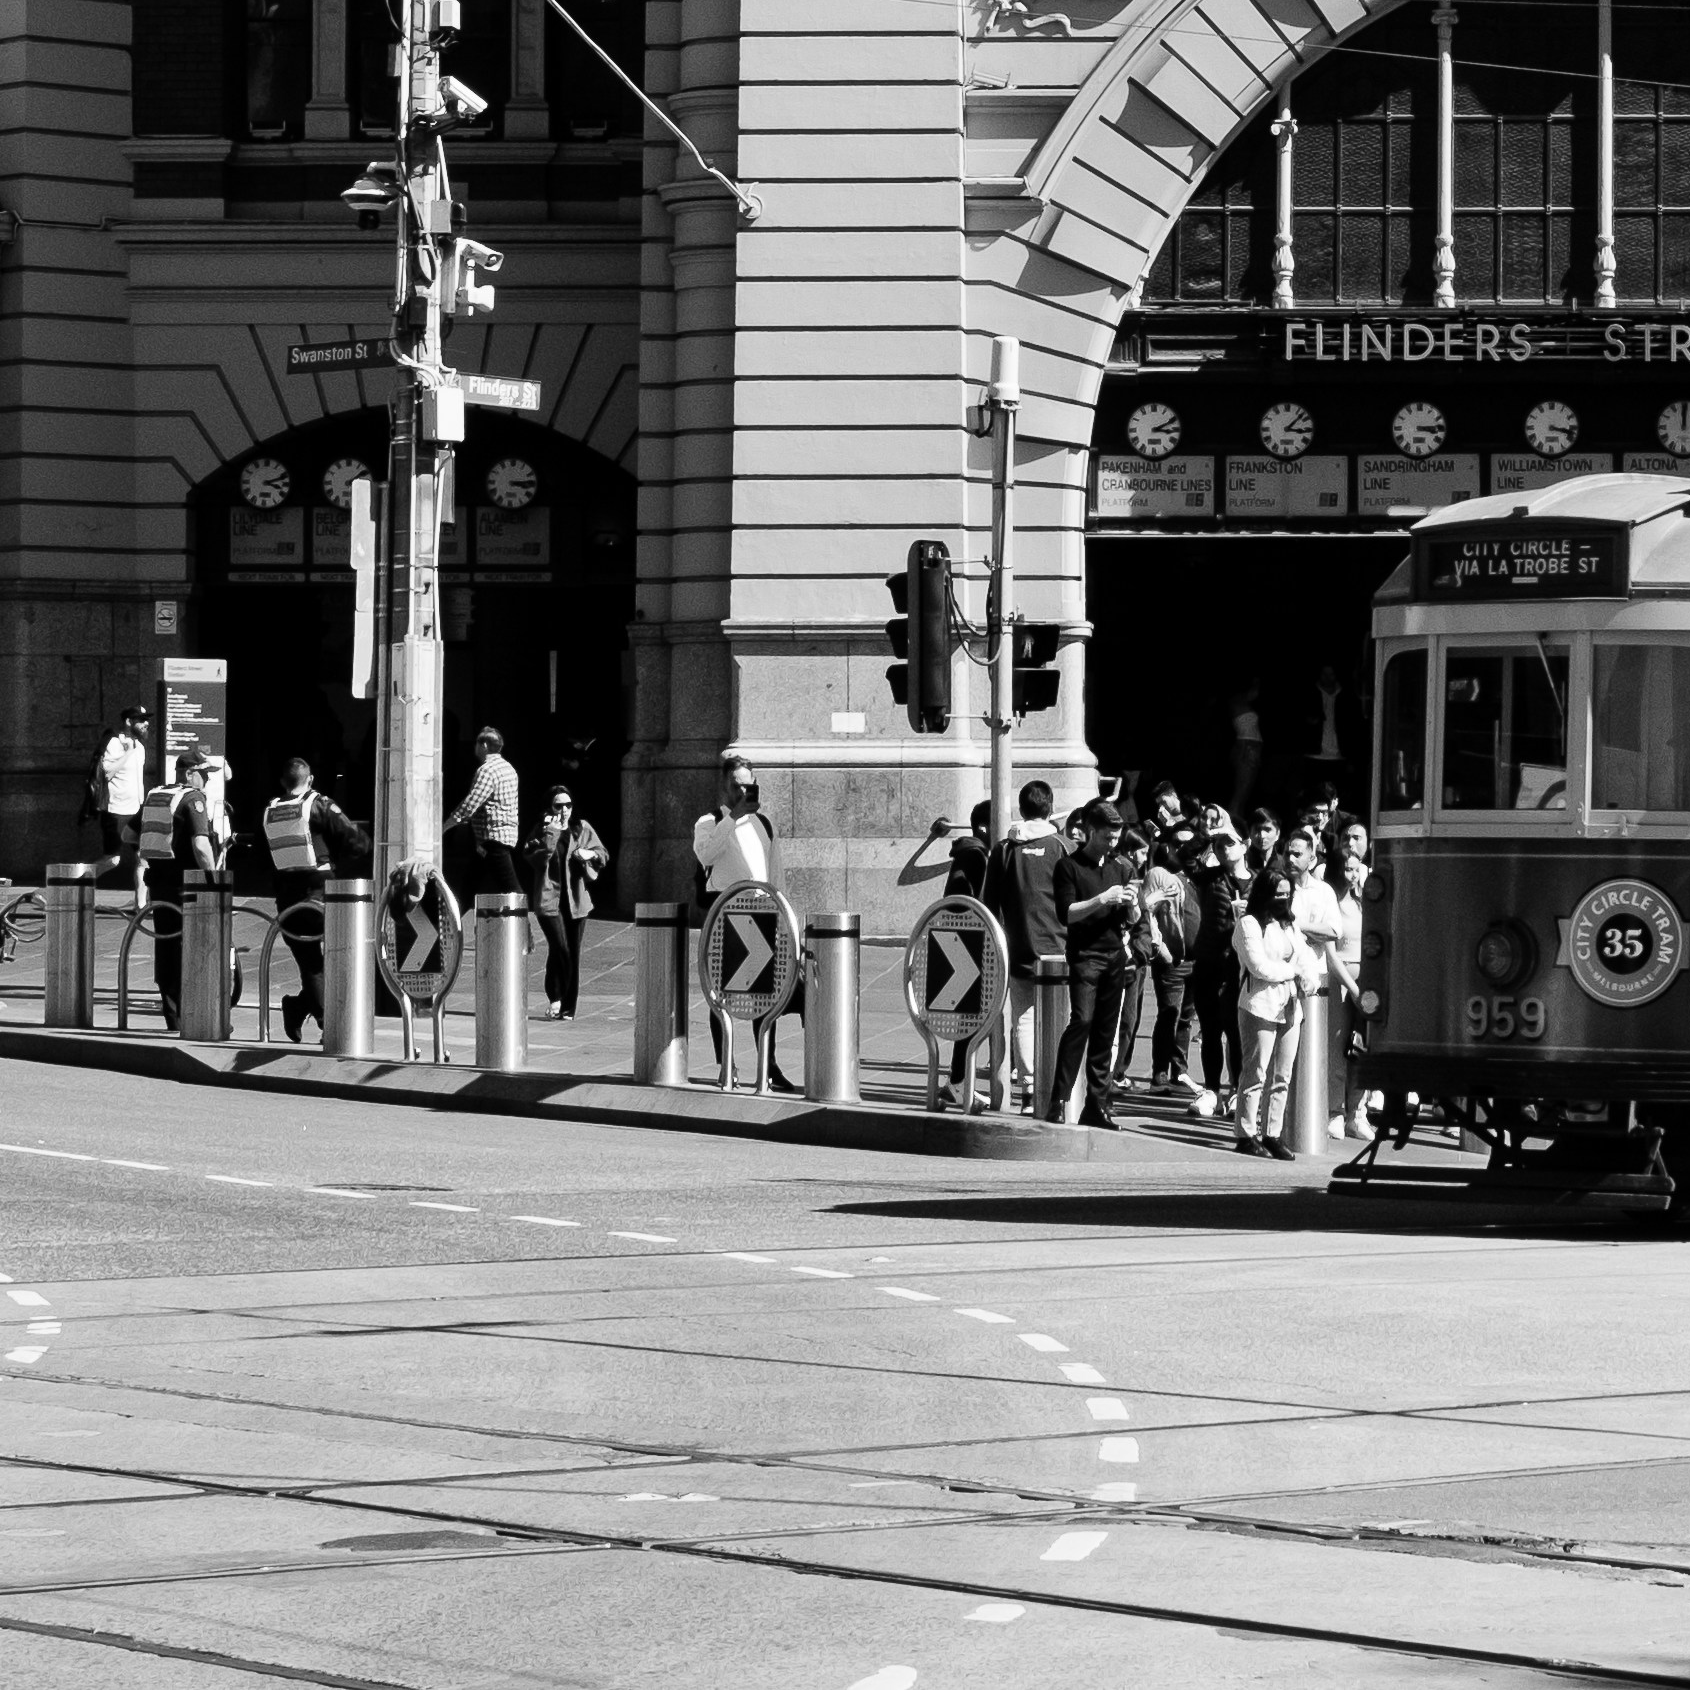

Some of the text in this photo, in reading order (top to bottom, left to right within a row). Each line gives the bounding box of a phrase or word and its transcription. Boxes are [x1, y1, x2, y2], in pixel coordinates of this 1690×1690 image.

[1285, 323, 1532, 361] FLINDERS
[291, 346, 351, 365] Swanston
[356, 343, 367, 359] St
[469, 376, 537, 399] Flinders St
[1101, 461, 1187, 475] PAKENHAM and
[1229, 461, 1303, 475] FRANKSTON
[1363, 460, 1455, 473] SANDRINGHAM
[1498, 459, 1592, 472] WILLIAMSTOWN
[1630, 459, 1678, 472] ALTONA
[1102, 478, 1212, 492] CRANBOURNE LINES
[1229, 478, 1256, 491] LINE
[1363, 477, 1391, 490] LINE
[1498, 476, 1524, 489] LINE
[1101, 497, 1149, 508] PLATFORM
[1229, 497, 1276, 508] PLATFORM
[1363, 496, 1411, 507] PLATFORM
[233, 513, 283, 525] LILYDALE
[315, 513, 351, 524] BELG
[480, 513, 529, 524] ALAMEIN
[233, 525, 258, 536] LINE
[315, 525, 340, 536] LINE
[479, 525, 504, 536] LINE
[1463, 542, 1501, 557] CITY
[1510, 540, 1572, 556] CIRCLE
[1455, 557, 1600, 575] VIA LA TROBE ST
[1577, 890, 1674, 964] CITY CIRCLE TRAM
[1604, 928, 1644, 958] 35
[1594, 971, 1655, 992] MELBOURNE
[1466, 995, 1545, 1038] 959
